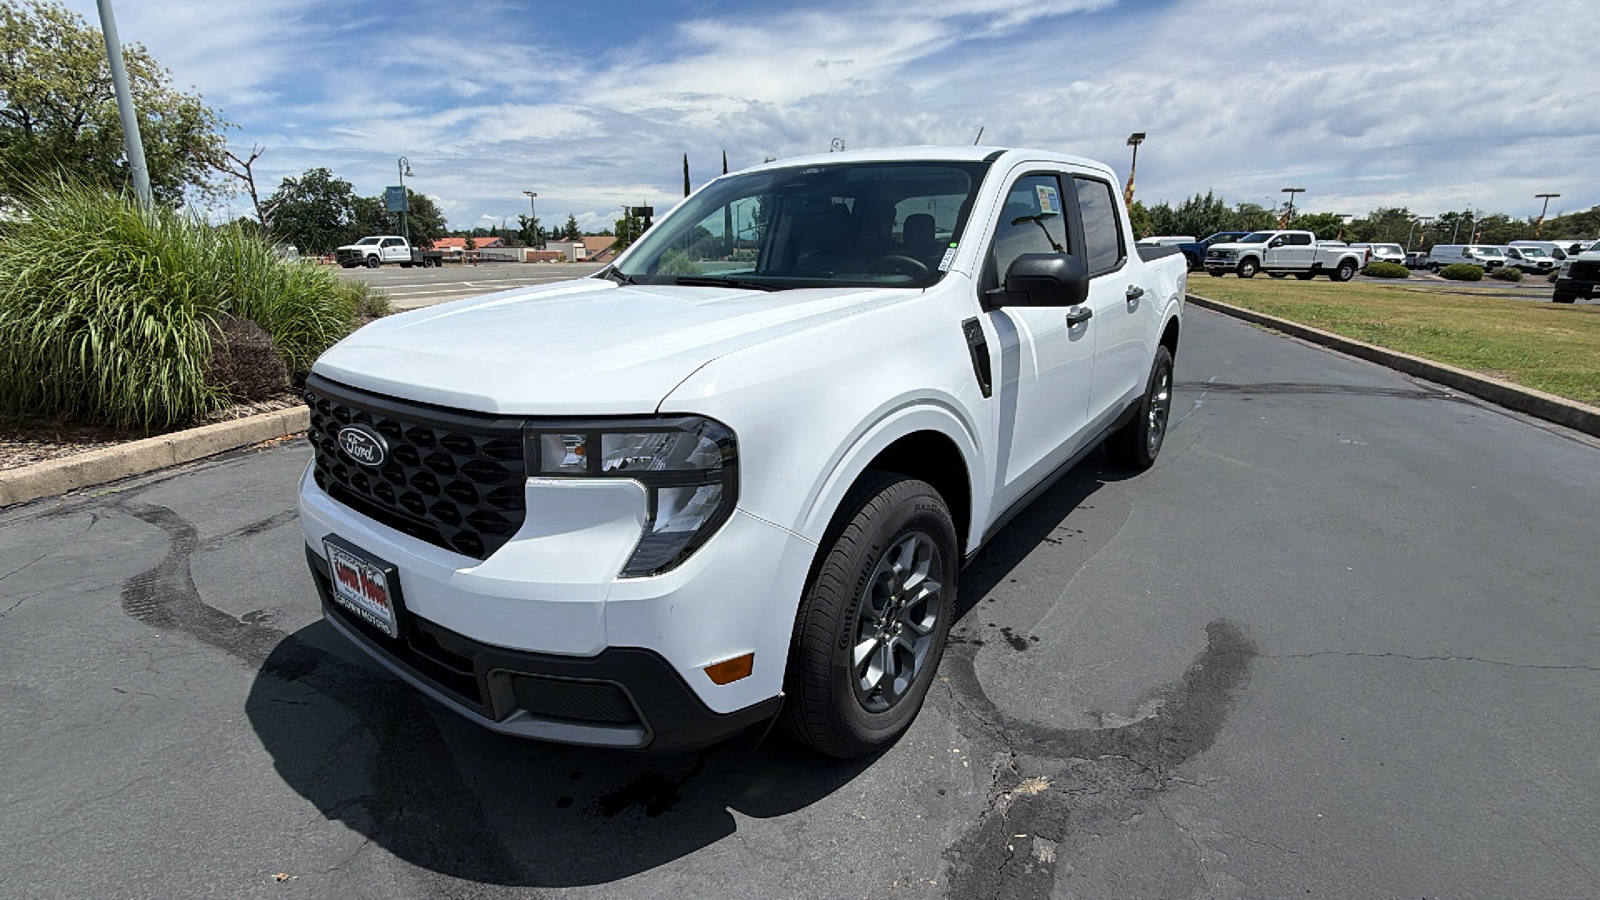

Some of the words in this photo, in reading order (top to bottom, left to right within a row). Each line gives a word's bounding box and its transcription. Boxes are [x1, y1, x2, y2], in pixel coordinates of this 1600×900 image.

[347, 432, 374, 461] Ford
[337, 595, 361, 615] CROWN
[361, 610, 391, 634] MOTORS
[839, 554, 874, 651] Continental
